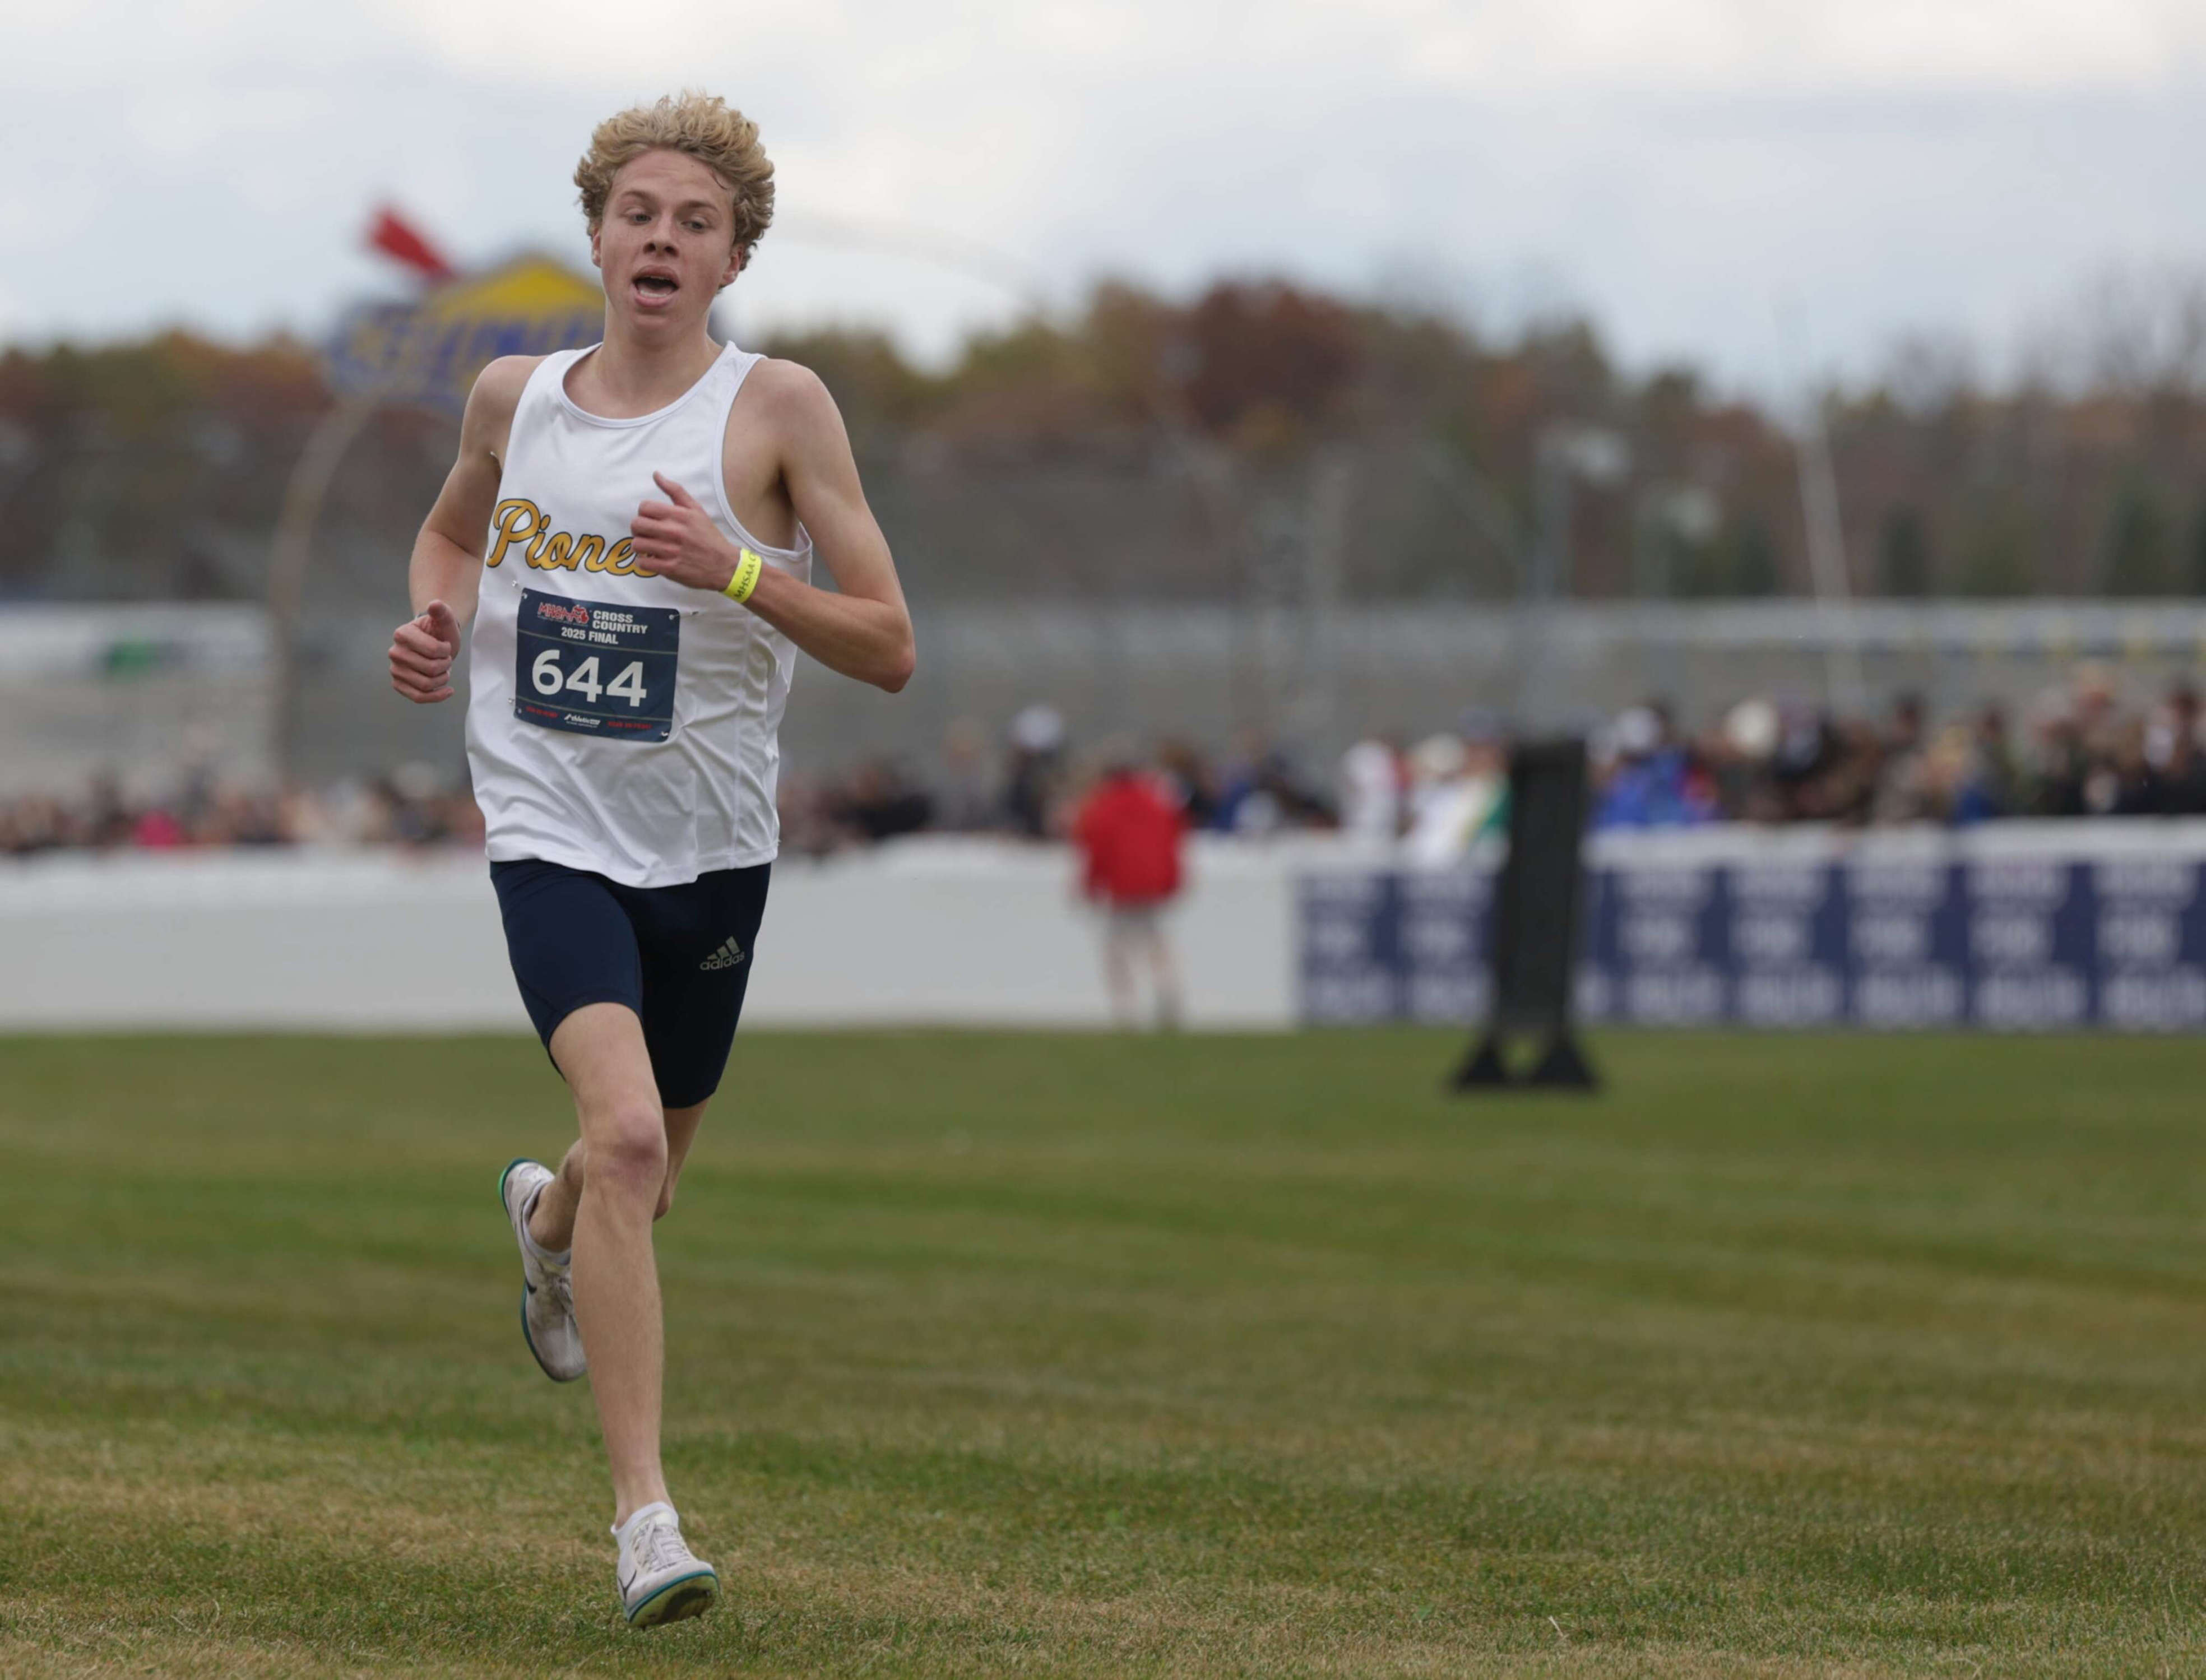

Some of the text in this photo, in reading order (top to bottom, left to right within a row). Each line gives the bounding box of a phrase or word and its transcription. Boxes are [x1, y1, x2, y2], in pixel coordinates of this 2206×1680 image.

[486, 498, 659, 578] Pione
[593, 610, 633, 623] CROSS
[562, 626, 619, 644] 2025 FINAL
[592, 620, 648, 634] COUNTRY
[532, 649, 647, 707] 644
[699, 951, 745, 971] adidas
